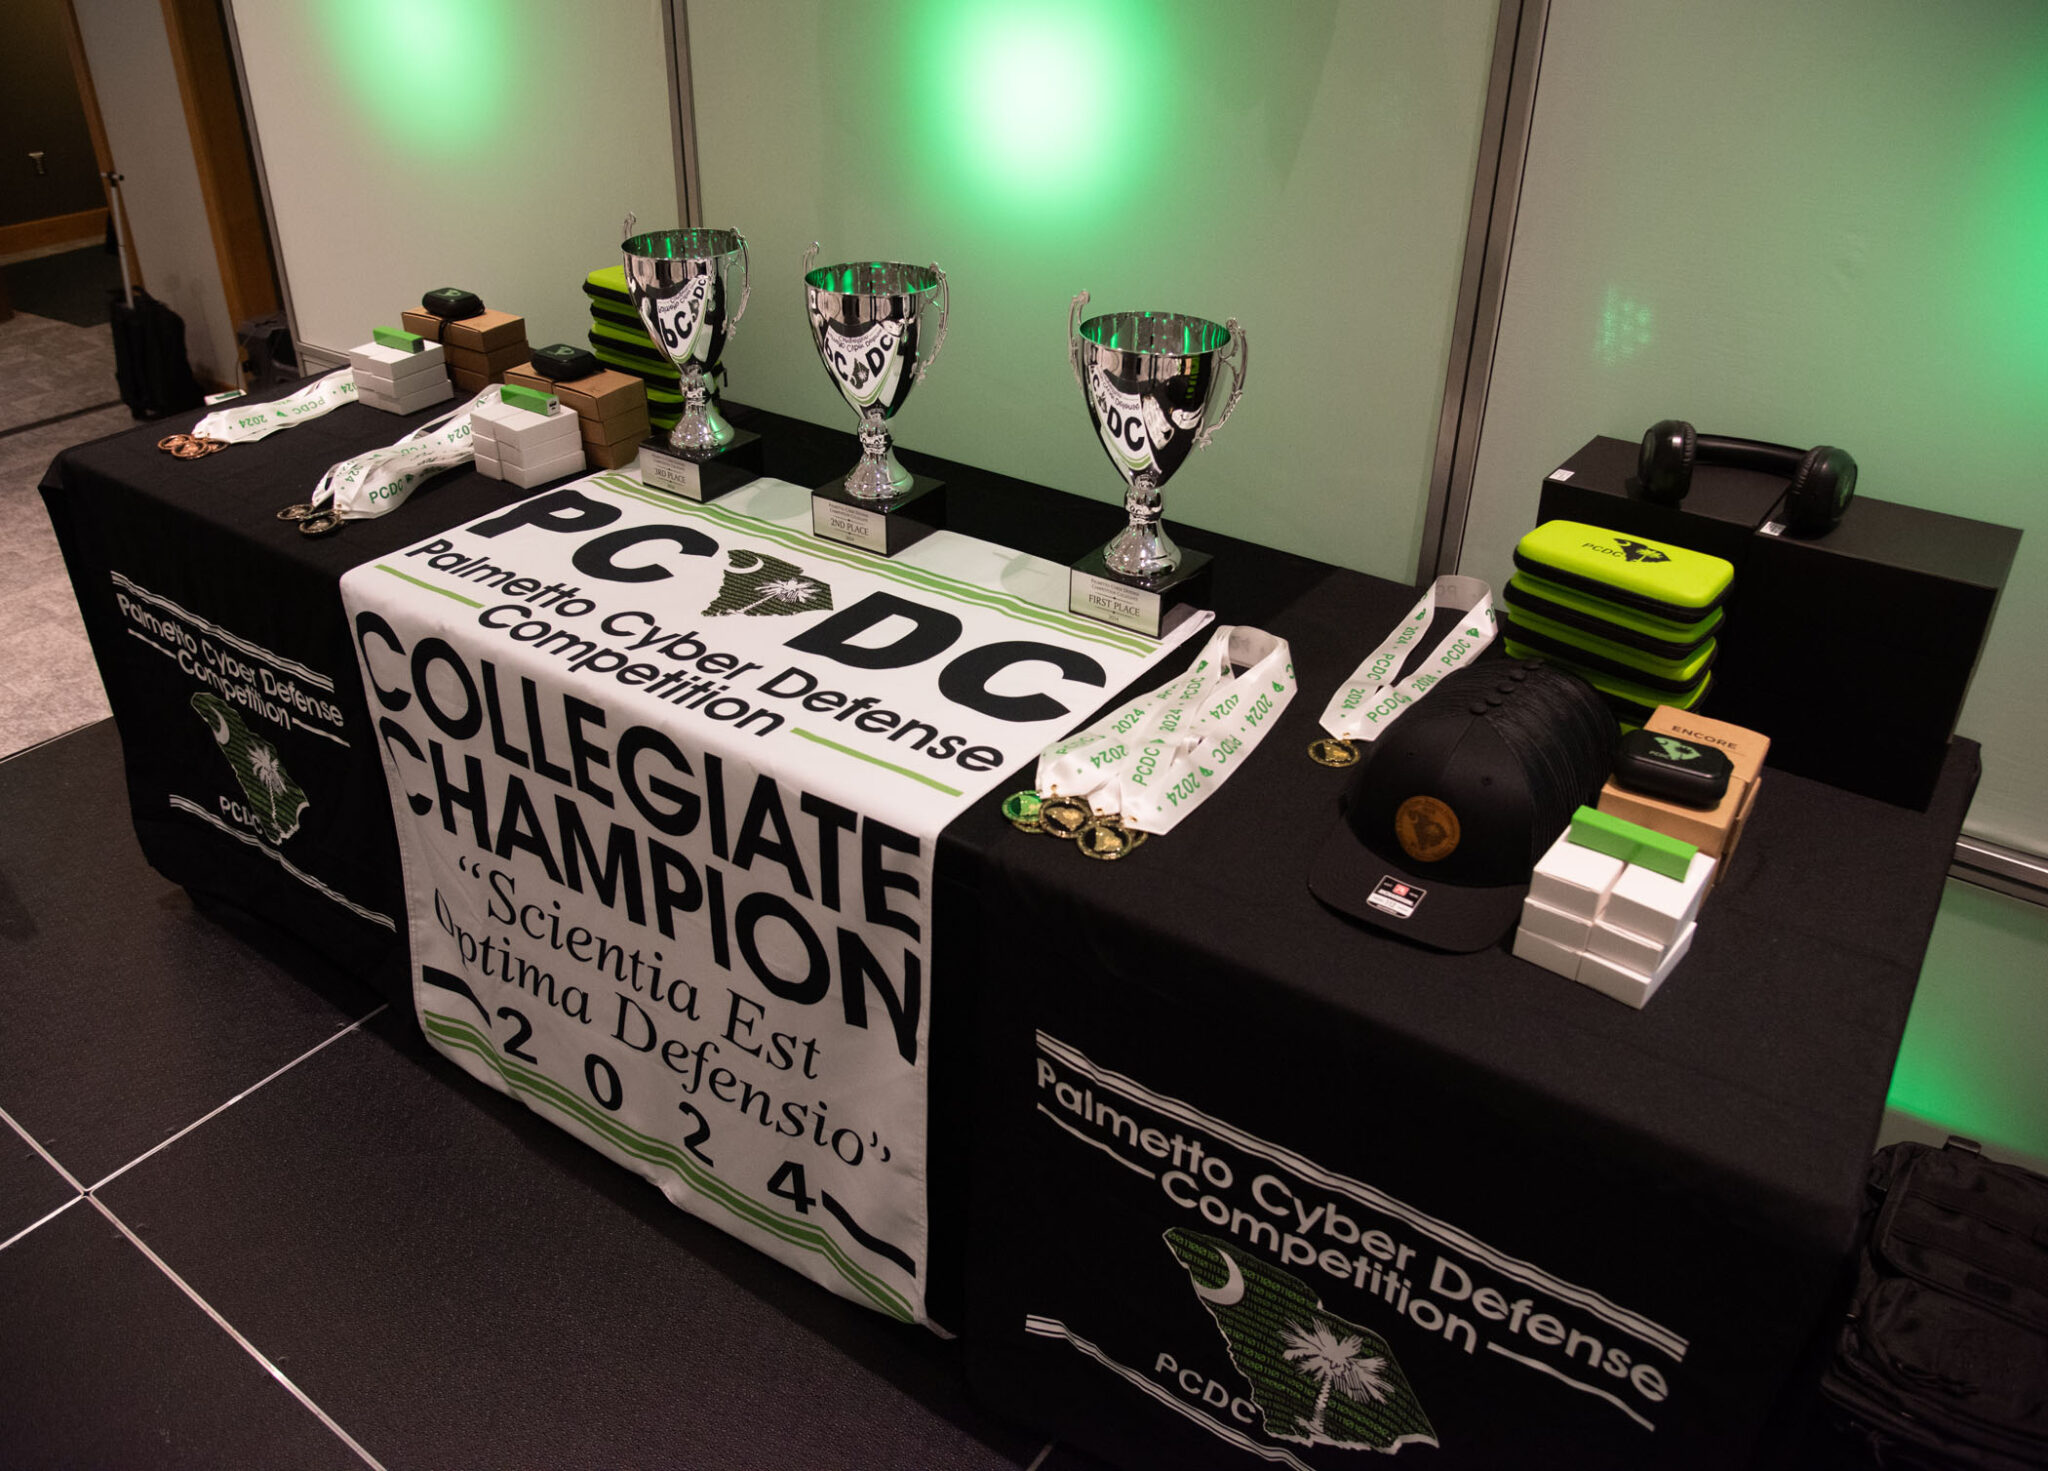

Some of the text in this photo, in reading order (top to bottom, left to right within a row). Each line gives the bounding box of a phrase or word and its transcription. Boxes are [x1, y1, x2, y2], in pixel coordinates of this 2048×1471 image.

[238, 414, 268, 429] 2024
[447, 421, 472, 443] 024
[369, 478, 403, 504] PCDC
[667, 471, 686, 483] PLACE
[831, 518, 869, 536] 2ND PLACE
[1581, 541, 1624, 558] PCDC
[466, 489, 719, 583] PC
[783, 591, 1107, 723] DC
[1088, 594, 1140, 617] FIRST PLACE
[116, 592, 345, 728] Palmetto Cyber Defense
[403, 538, 1005, 773] Palmetto Cyber Defense
[1367, 652, 1396, 681] PCDC
[1441, 638, 1472, 667] PCDC
[477, 604, 786, 738] Competition
[1411, 674, 1438, 693] 2024
[177, 648, 292, 731] Competition
[1341, 688, 1366, 710] 2024
[1112, 708, 1146, 734] 2024
[1159, 709, 1183, 732] 2024
[1245, 693, 1273, 727] 2024
[1366, 691, 1405, 723] PCDC
[1671, 724, 1738, 750] ENCORE
[1090, 744, 1129, 769] 2024
[1132, 747, 1160, 786] PCDC
[356, 611, 921, 943] COLLEGIATE
[1166, 772, 1200, 807] 2024
[379, 716, 922, 1066] CHAMPION
[434, 887, 592, 1024] Optima
[720, 987, 822, 1080] Est
[1036, 1058, 1233, 1189] Palmetto
[1251, 1173, 1417, 1272] Cyber
[1429, 1255, 1669, 1402] Defense
[1161, 1171, 1478, 1354] Competition
[1154, 1352, 1258, 1424] PCDC
